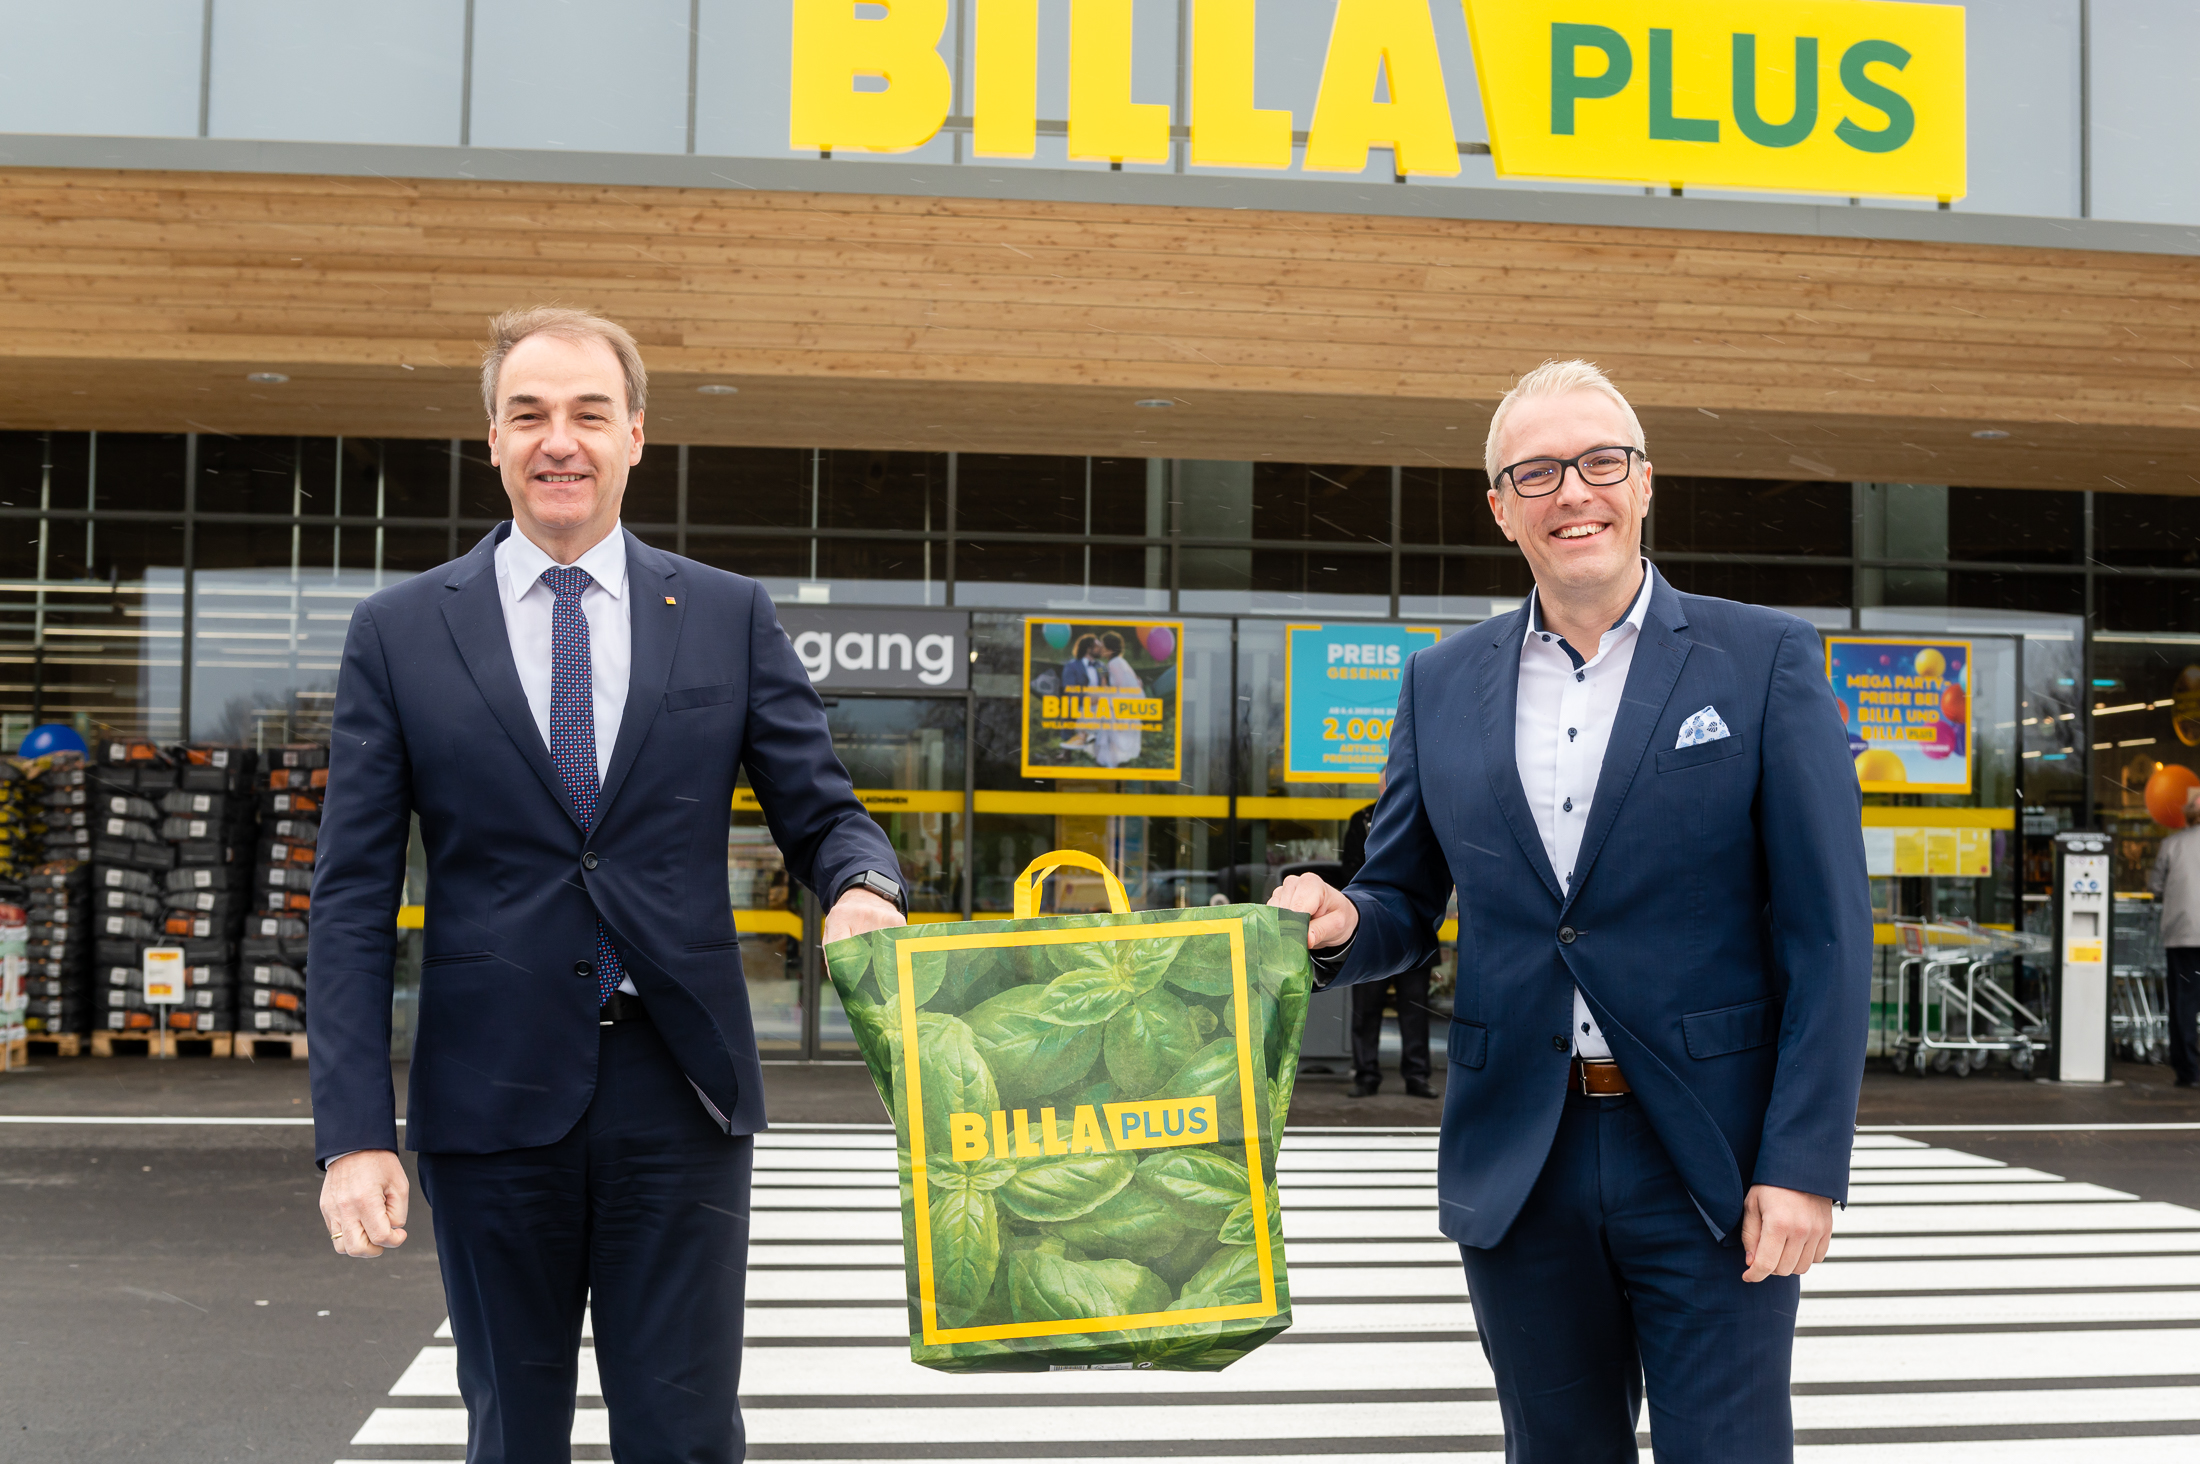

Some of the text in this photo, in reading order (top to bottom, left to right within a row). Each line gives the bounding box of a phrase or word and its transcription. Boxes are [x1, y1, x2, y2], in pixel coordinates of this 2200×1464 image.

[789, 0, 1915, 177] BILLA PLUS
[788, 631, 954, 685] gang
[1327, 643, 1401, 665] PREIS
[1327, 667, 1401, 680] GESENKT
[1846, 674, 1951, 690] MEGA PARTY-
[1042, 695, 1158, 719] BILLA PLUS
[1859, 691, 1939, 706] PREISE BEI
[1858, 707, 1940, 723] BILLA UND
[1861, 725, 1934, 741] BILLA PLUS
[949, 1104, 1208, 1162] BILLA PLUS
